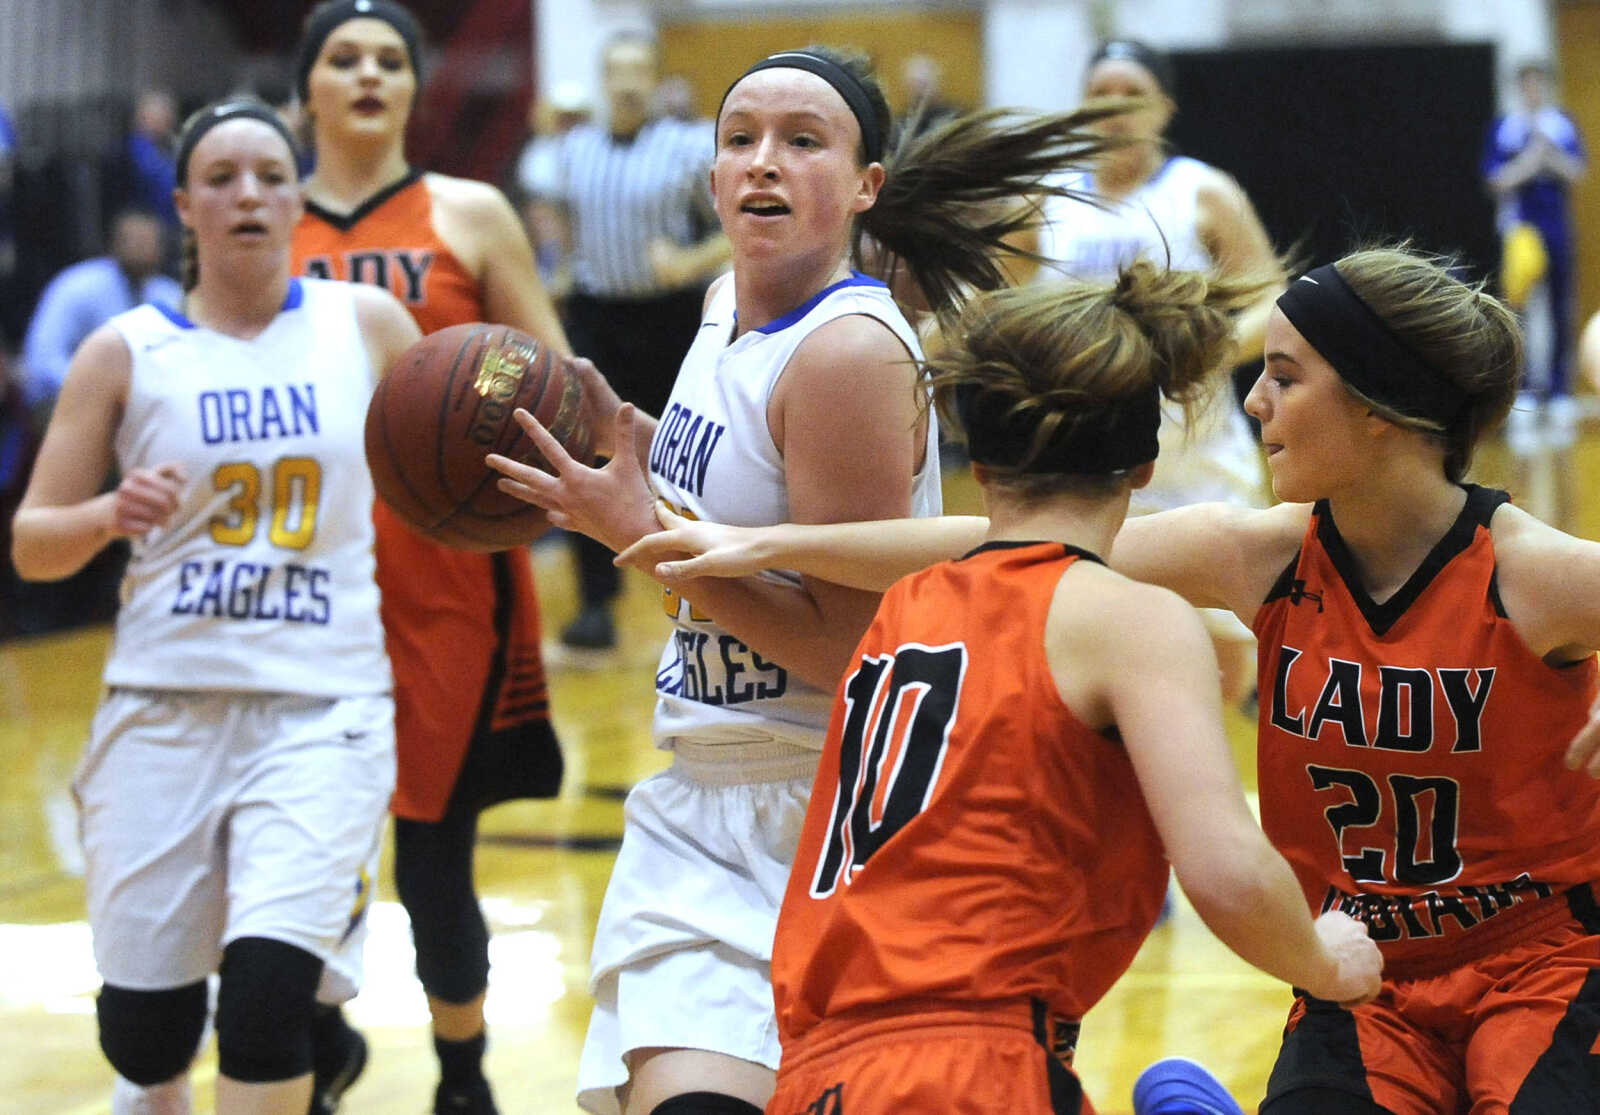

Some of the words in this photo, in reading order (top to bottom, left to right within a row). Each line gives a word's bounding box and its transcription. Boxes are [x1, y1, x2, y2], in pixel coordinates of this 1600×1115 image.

[302, 250, 437, 306] ADY
[198, 383, 320, 444] ORAN
[651, 402, 725, 497] ORAN
[209, 455, 323, 550] 30
[171, 560, 331, 625] EAGLES
[1270, 645, 1497, 753] LADY
[809, 641, 969, 899] 10
[1305, 763, 1464, 886] 20
